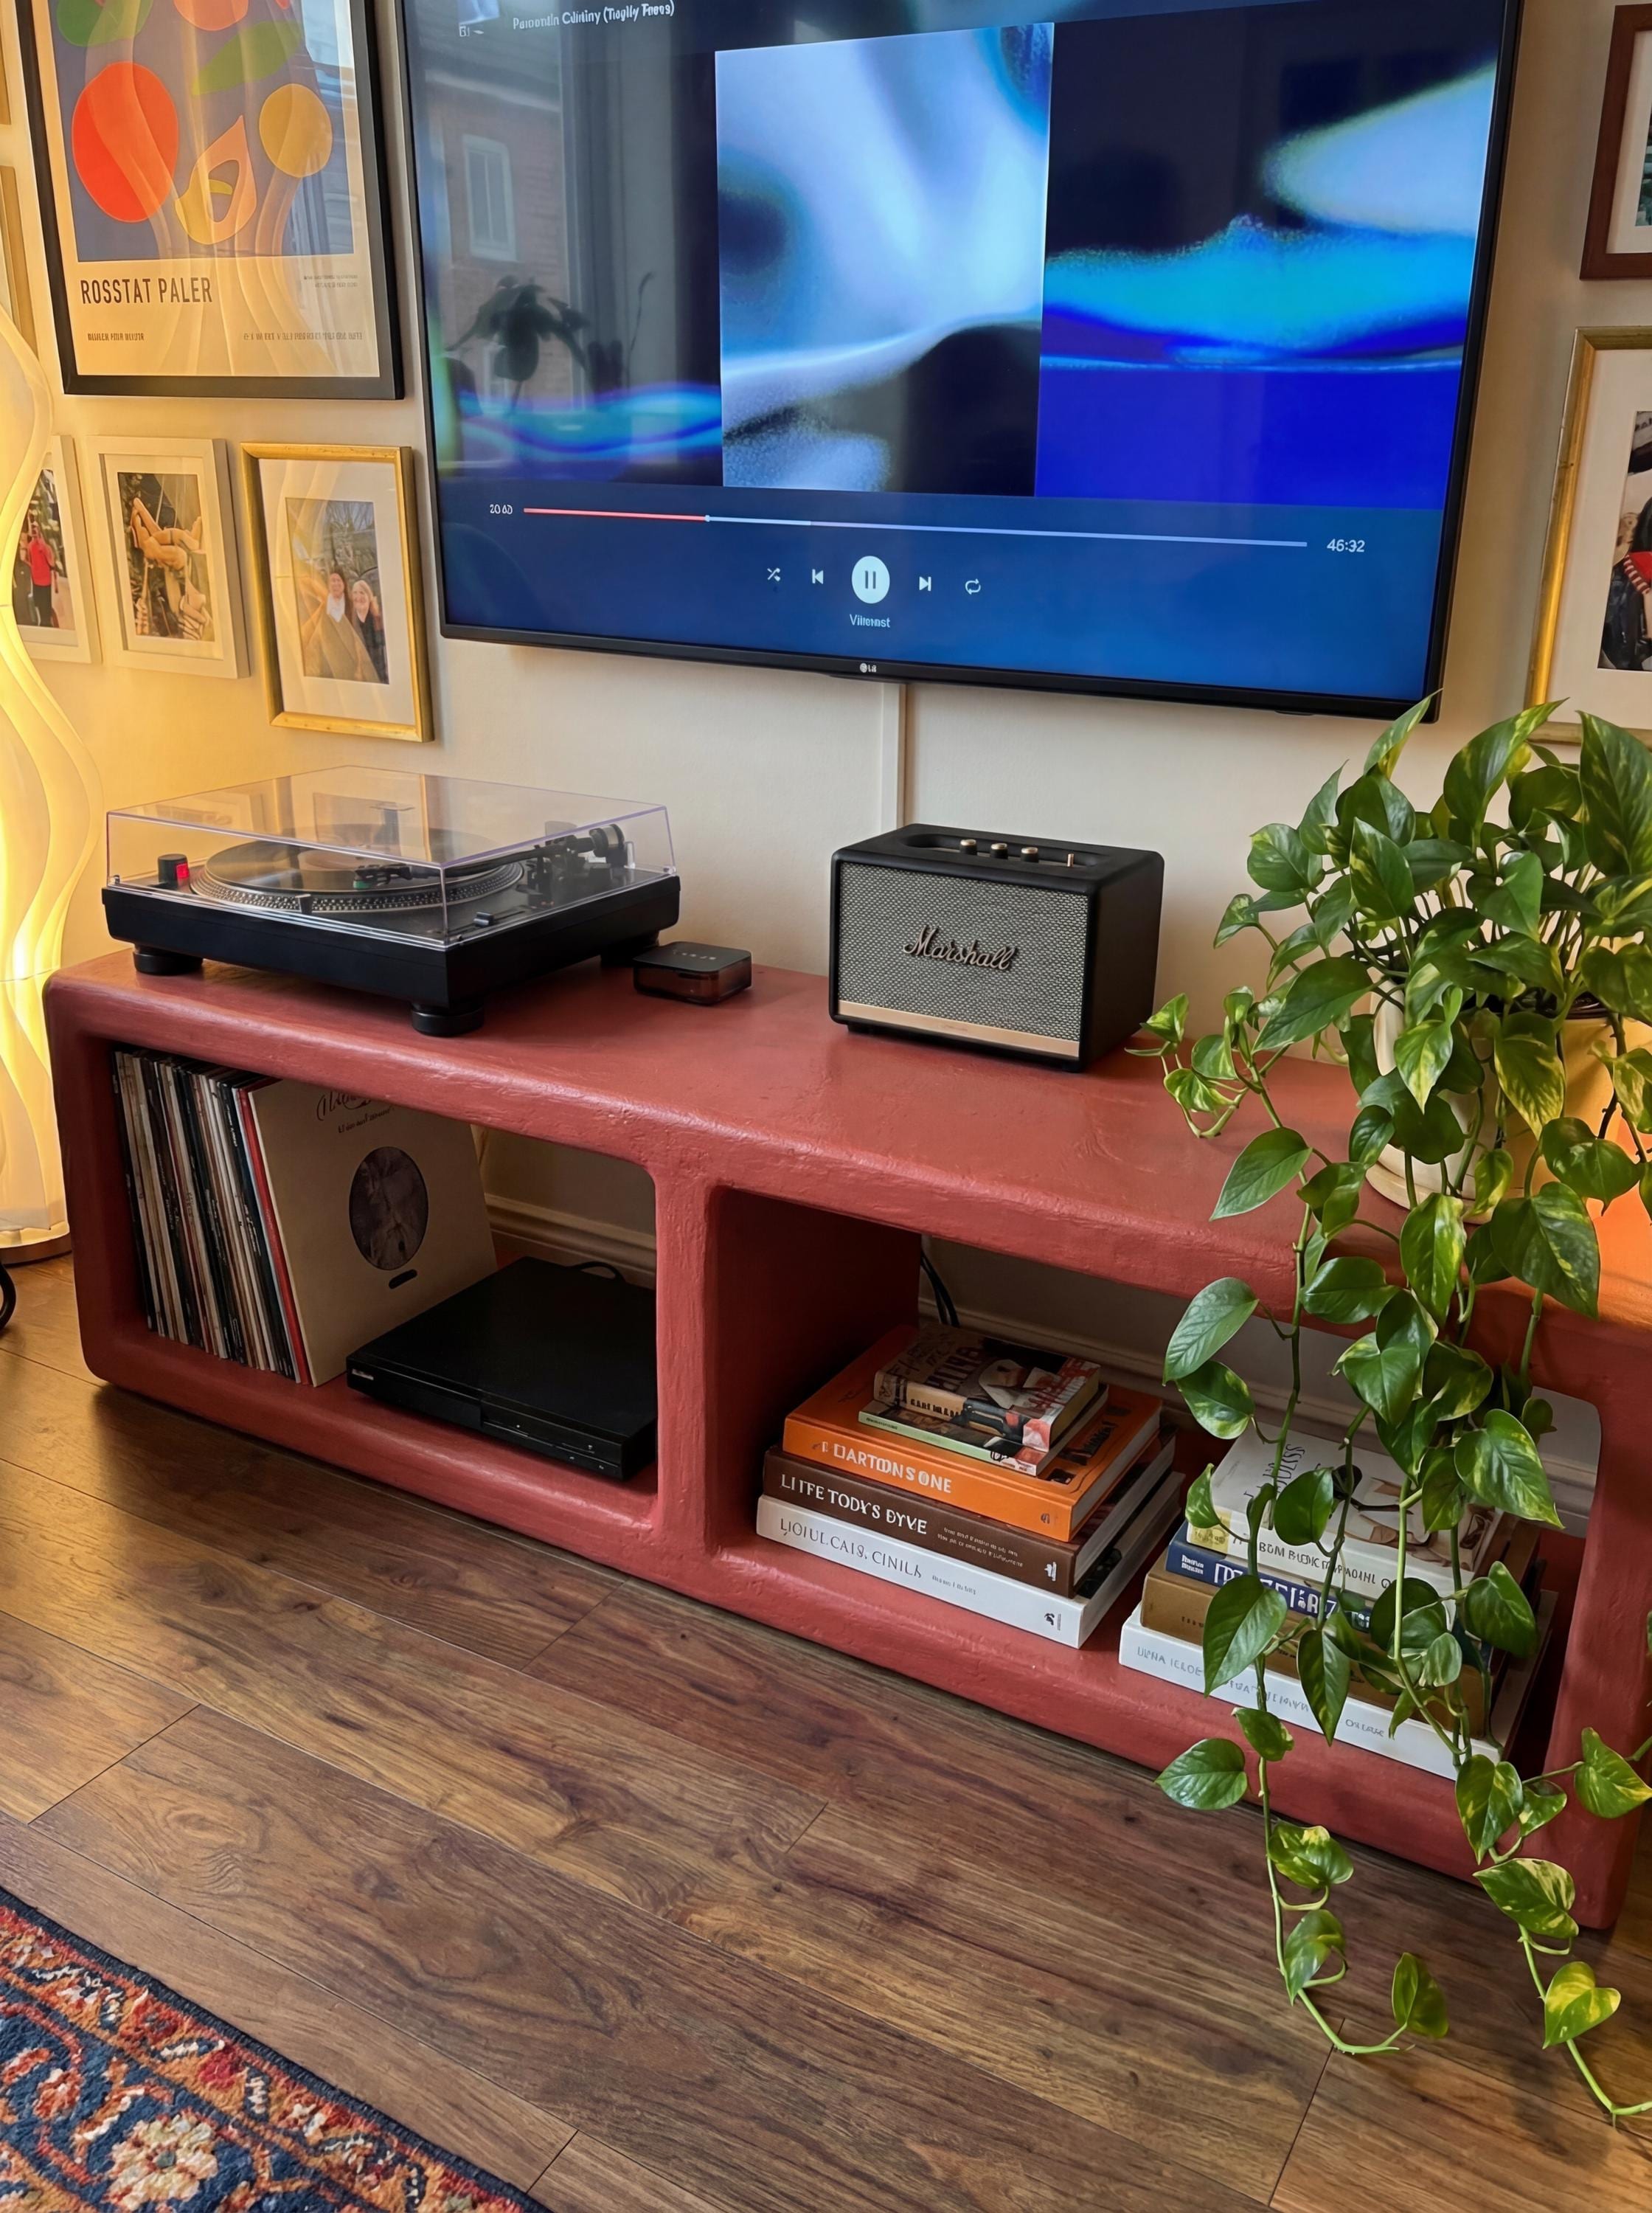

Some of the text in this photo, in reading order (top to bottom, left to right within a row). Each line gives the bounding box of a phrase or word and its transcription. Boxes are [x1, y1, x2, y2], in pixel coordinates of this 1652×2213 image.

[80, 277, 213, 304] ROSSTAT PALER
[1327, 538, 1365, 553] 46:32
[903, 924, 1018, 971] Marshall
